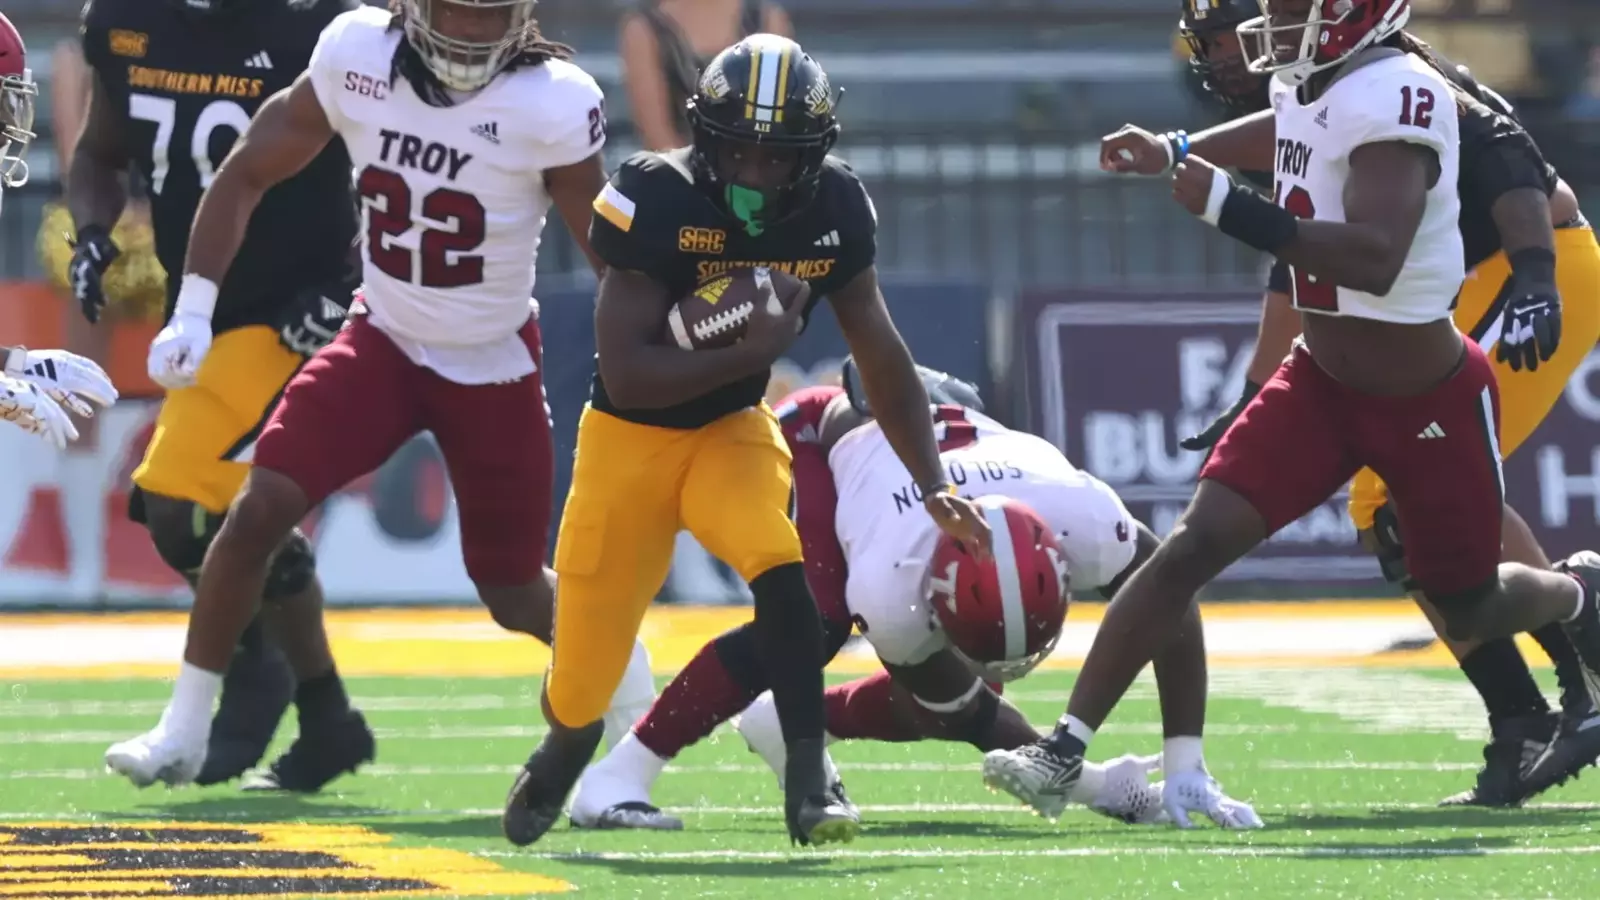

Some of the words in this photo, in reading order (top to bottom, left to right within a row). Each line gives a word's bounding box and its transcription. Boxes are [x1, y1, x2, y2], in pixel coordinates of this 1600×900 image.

[128, 65, 213, 93] SOUTHERN
[215, 74, 264, 97] MISS
[344, 70, 388, 100] SBC
[1399, 85, 1435, 129] 12
[128, 93, 253, 195] 70
[379, 129, 473, 181] TROY
[1276, 138, 1313, 179] TROY
[357, 164, 486, 287] 22
[679, 226, 726, 254] SBC
[794, 258, 836, 278] MISS
[892, 460, 1023, 514] SOLOON
